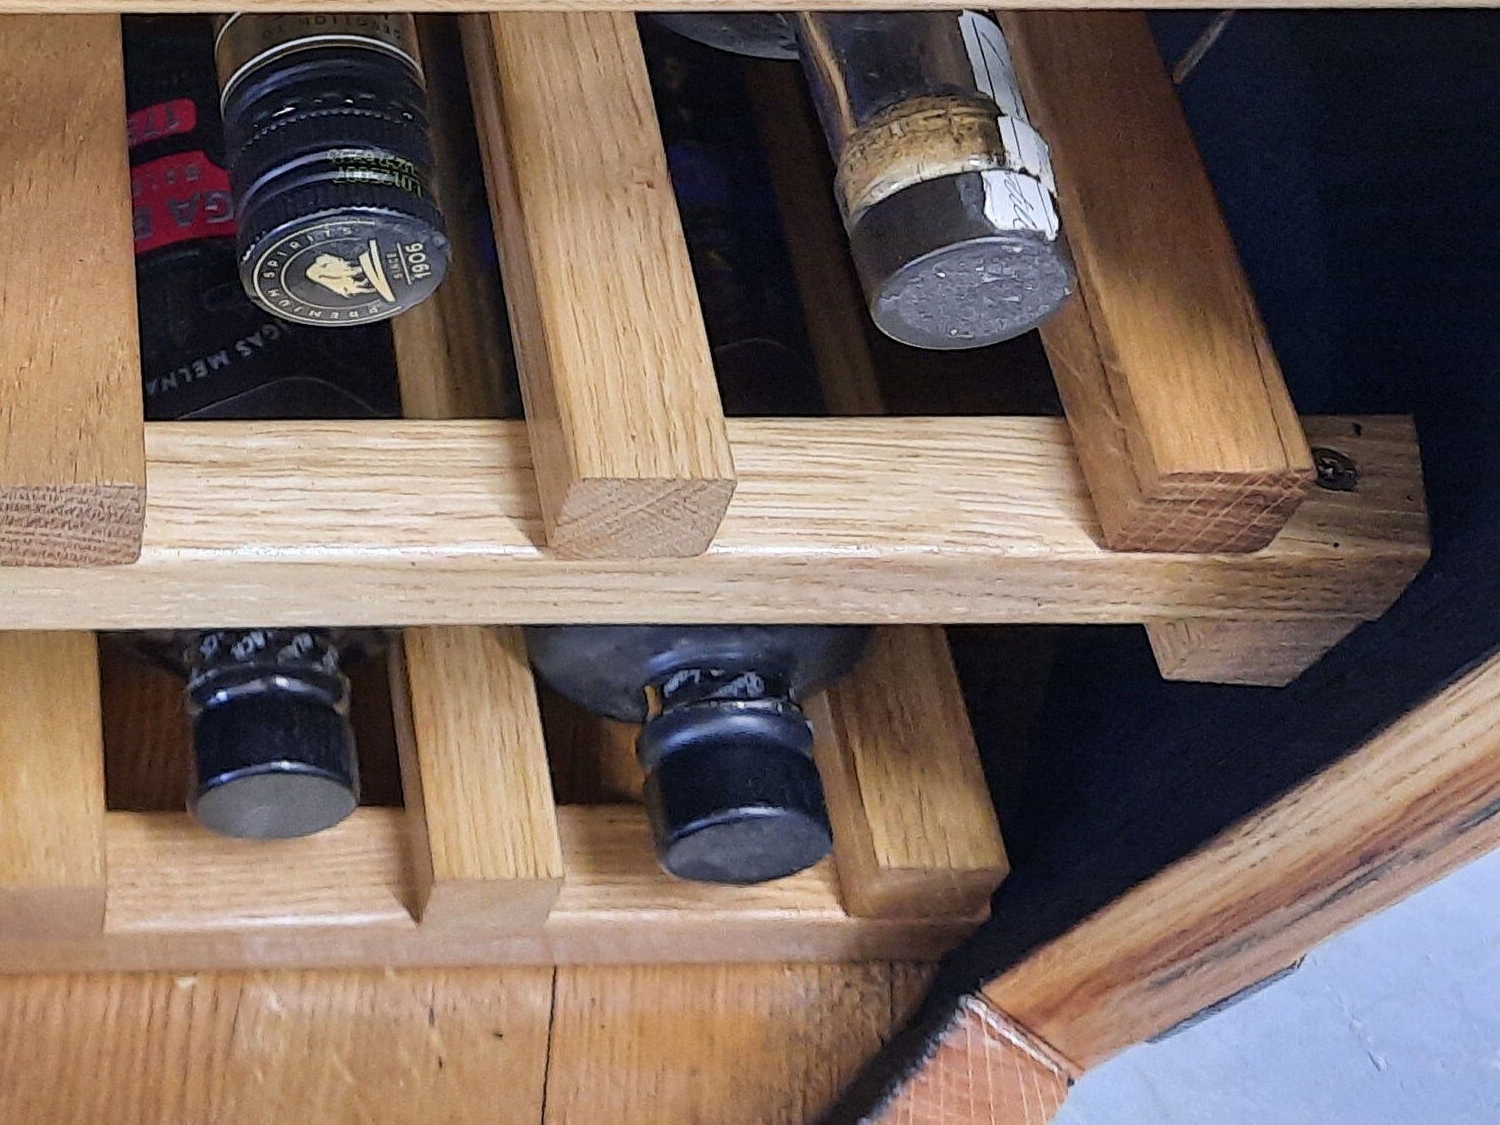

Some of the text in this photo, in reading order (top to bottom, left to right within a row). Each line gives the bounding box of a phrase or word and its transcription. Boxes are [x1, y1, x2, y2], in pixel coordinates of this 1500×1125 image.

[262, 227, 354, 279] SPIRITS
[404, 242, 432, 282] 1906
[267, 288, 381, 319] PREMIUM
